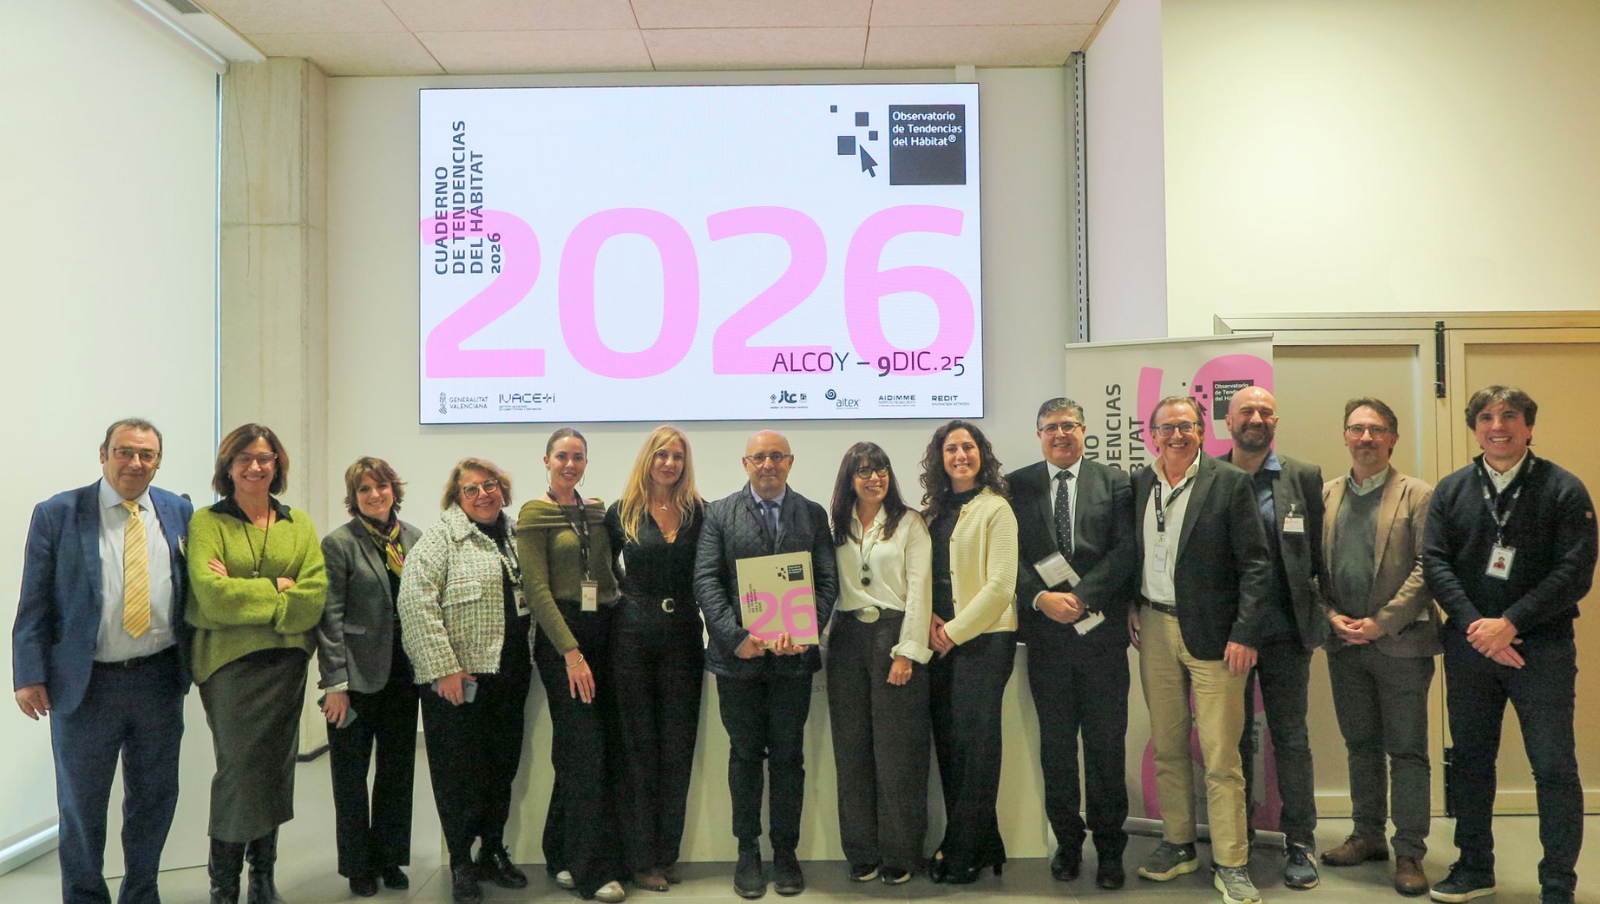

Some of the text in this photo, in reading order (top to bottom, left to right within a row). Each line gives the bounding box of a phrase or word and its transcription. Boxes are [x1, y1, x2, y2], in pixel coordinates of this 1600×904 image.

[892, 111, 956, 121] Observatorio
[892, 124, 963, 133] de Tendencias
[892, 136, 909, 146] del
[452, 120, 466, 275] DE TENDENCIAS
[466, 150, 484, 275] DEL HÁBITAT
[434, 165, 448, 275] CUADERNO
[487, 232, 501, 274] 2026
[420, 204, 976, 379] 2026
[772, 351, 850, 372] ALCOY
[877, 351, 966, 377] 9DIC.25
[835, 397, 860, 408] aitex
[741, 586, 818, 641] 26
